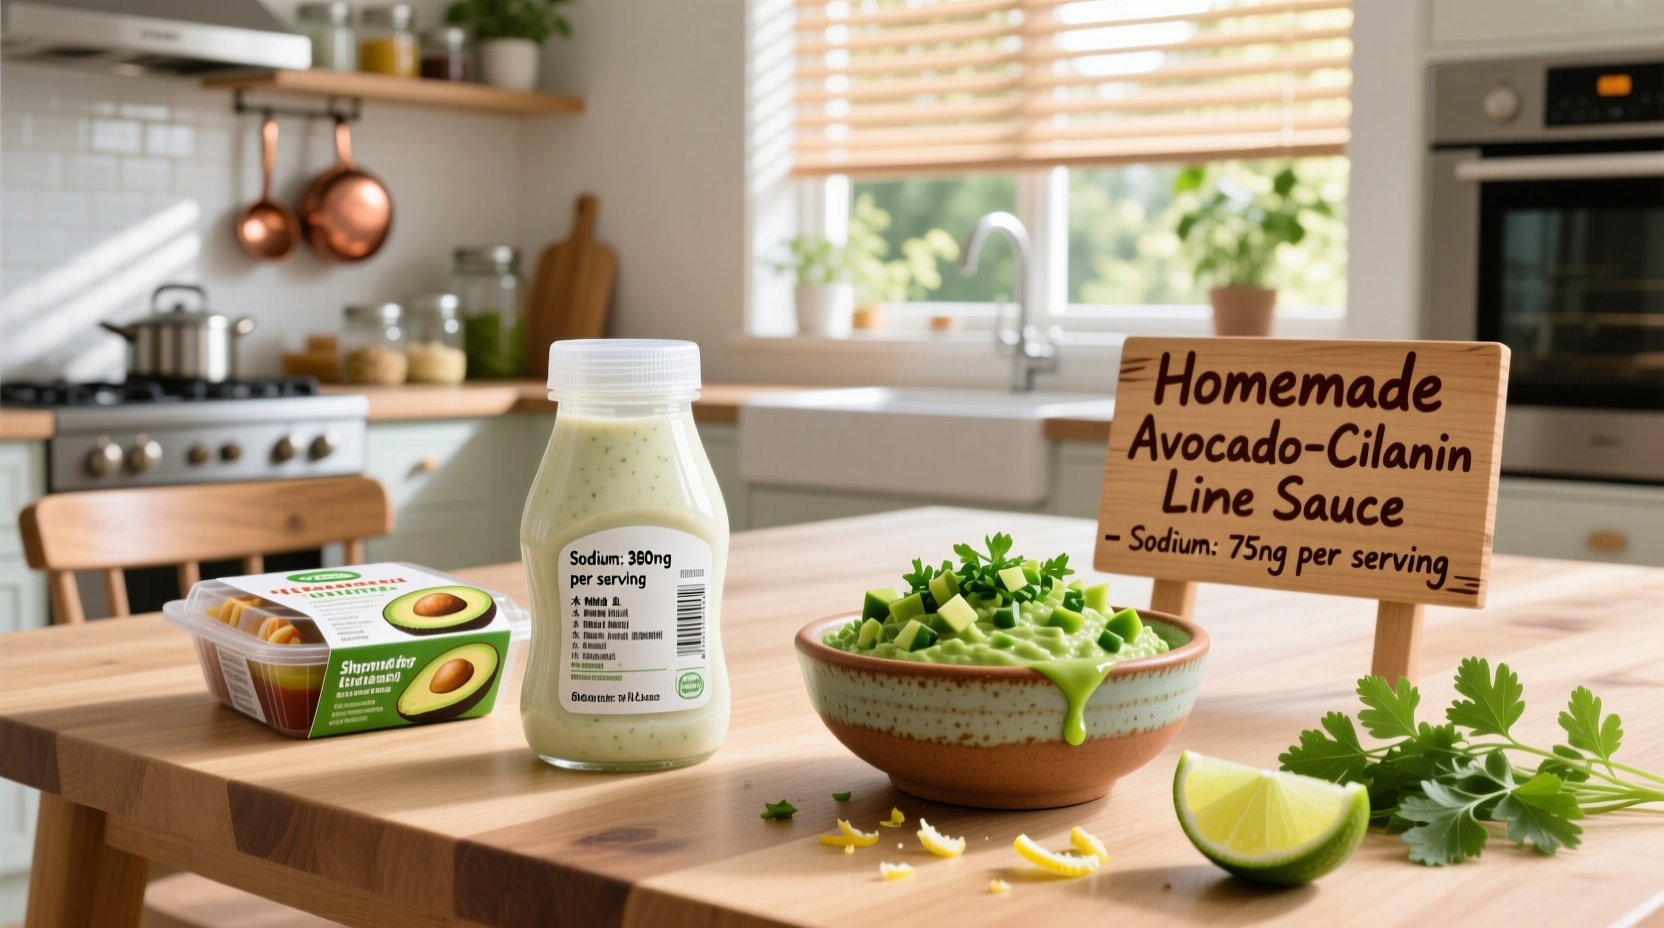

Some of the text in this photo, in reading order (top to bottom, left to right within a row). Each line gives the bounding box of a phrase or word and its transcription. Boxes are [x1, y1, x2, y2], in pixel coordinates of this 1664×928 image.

[1153, 350, 1442, 413] Homemade
[1127, 413, 1472, 473] Avocado-Cilanin
[1162, 468, 1405, 528] Line Sauce
[569, 549, 625, 567] Sodium:
[570, 571, 647, 589] per serving
[1128, 524, 1219, 556] Sodium:
[1229, 534, 1288, 577] 75ng
[1295, 545, 1342, 577] per
[1350, 545, 1449, 591] serving
